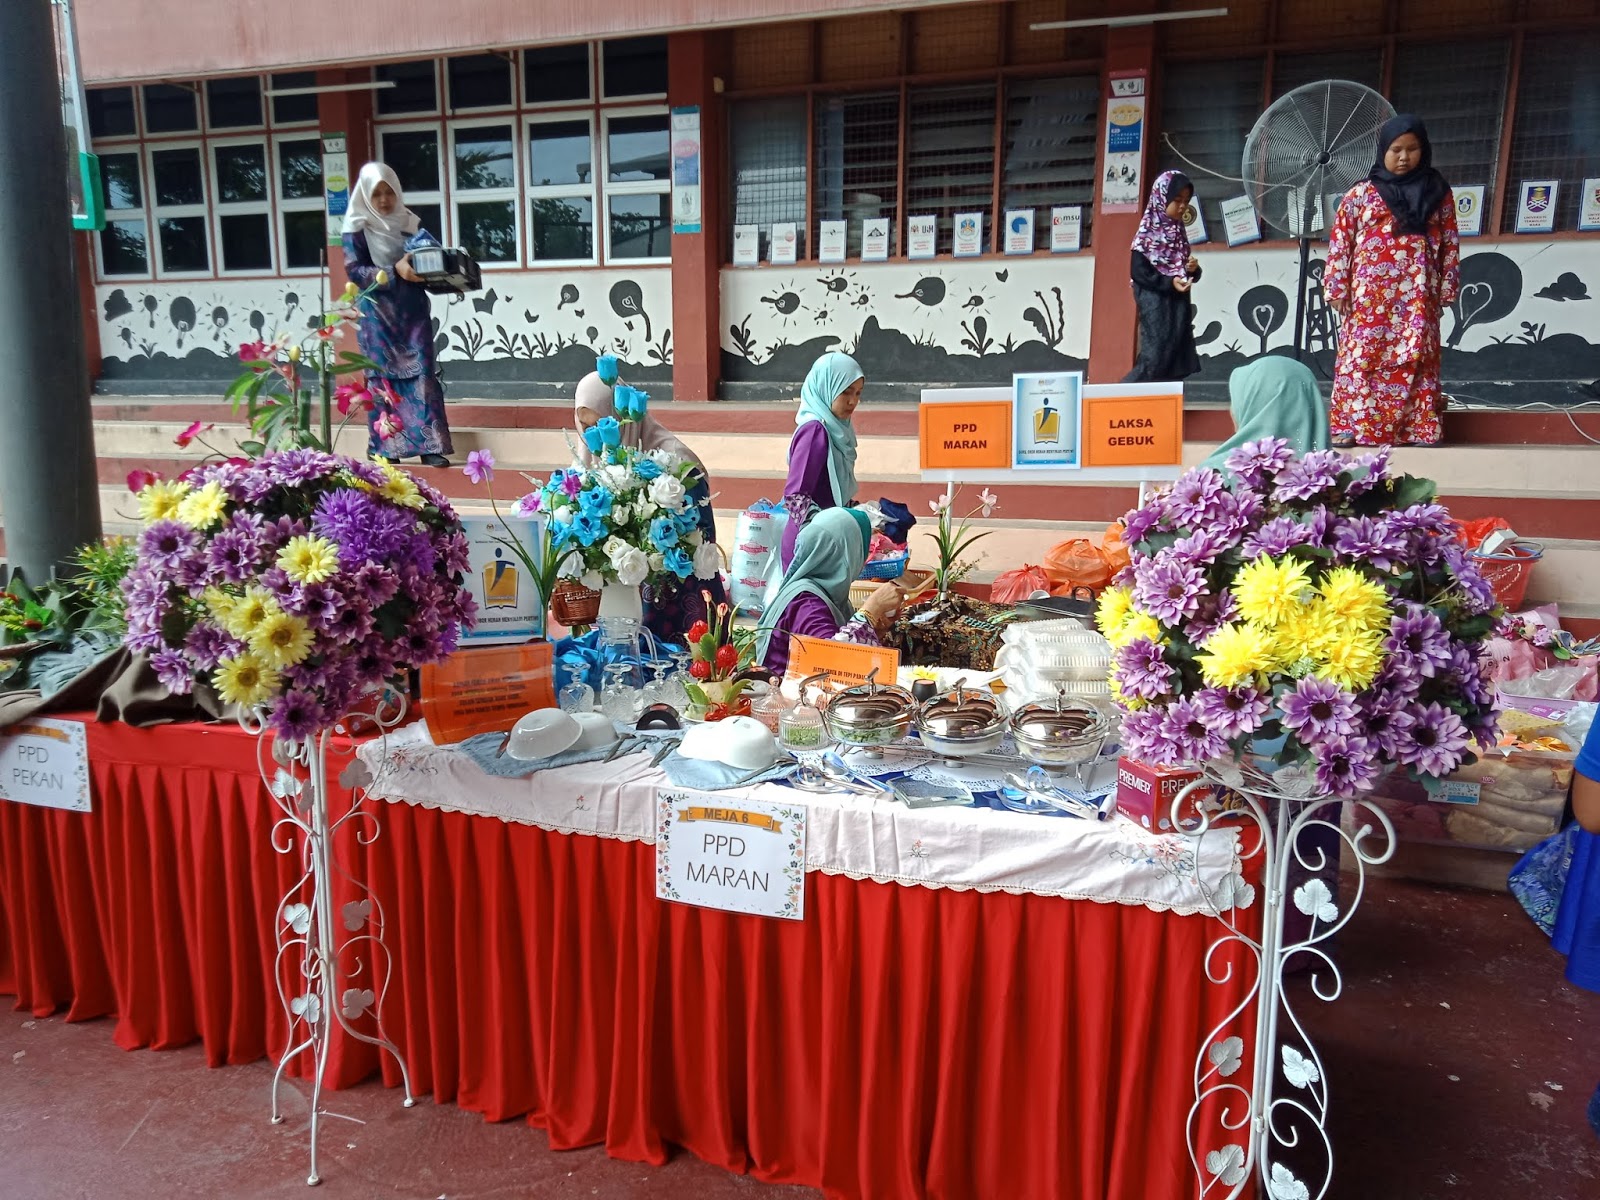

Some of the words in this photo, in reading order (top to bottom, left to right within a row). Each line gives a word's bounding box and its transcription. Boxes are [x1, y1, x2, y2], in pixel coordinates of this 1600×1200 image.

[953, 423, 978, 434] PPD
[1109, 418, 1154, 430] LAKSA
[943, 439, 988, 450] MARAN
[1108, 435, 1155, 447] GEBUK
[18, 745, 49, 763] PPD
[13, 768, 63, 790] PEKAN
[1119, 768, 1152, 795] PREMIER
[704, 808, 738, 823] MEJA
[742, 812, 749, 823] 6
[703, 833, 746, 857] PPD
[686, 861, 769, 892] MARAN
